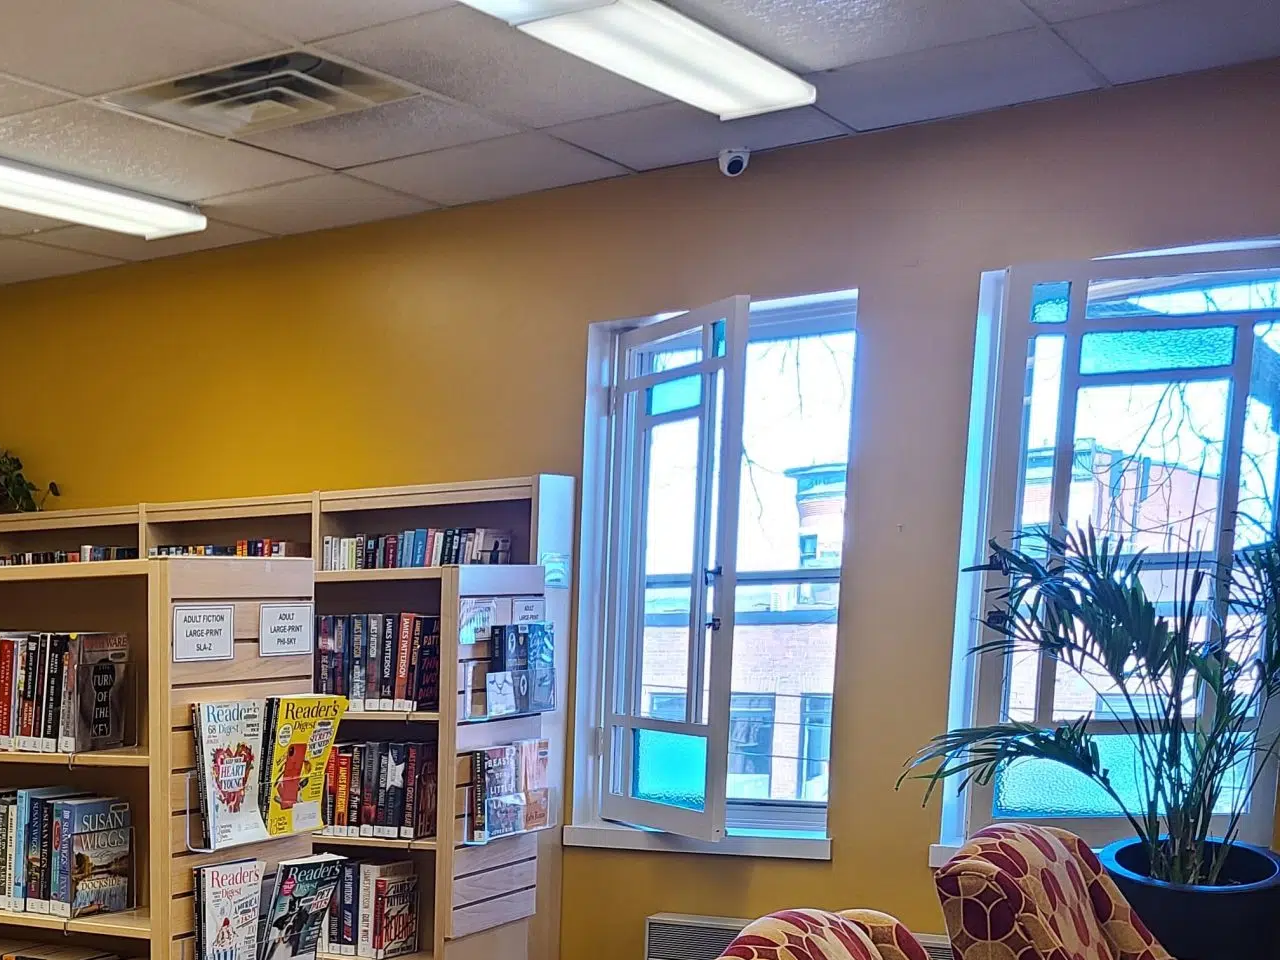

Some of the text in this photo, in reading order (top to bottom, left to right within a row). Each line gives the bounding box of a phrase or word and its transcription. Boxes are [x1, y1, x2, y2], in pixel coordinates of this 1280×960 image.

[183, 614, 225, 624] ADULT FICTION
[278, 612, 295, 621] ADULT
[185, 628, 223, 638] LARGE-PRINT
[270, 624, 303, 633] LARGE-PRINT
[106, 636, 128, 648] WARE
[196, 642, 212, 652] SLA-Z
[276, 637, 297, 646] PHI-SKY
[399, 618, 410, 678] JAMES PATTERSON
[381, 618, 393, 697] JAMES PATTERSON 14
[94, 674, 114, 686] TURN
[97, 692, 108, 702] OF
[95, 706, 109, 718] THE
[206, 702, 260, 723] Reader's
[285, 700, 340, 720] Reader's
[92, 723, 109, 737] KEY
[218, 723, 239, 736] Digest
[294, 720, 317, 732] Digest
[221, 764, 245, 779] HEART
[222, 779, 242, 789] YOUNG
[337, 767, 347, 812] JAMES PATTERSON
[83, 810, 125, 831] SUSAN
[31, 829, 39, 855] WIGGS
[60, 821, 70, 865] SUSAN WIGGS
[80, 830, 125, 851] WIGGS
[40, 841, 48, 868] WIGGS
[211, 866, 260, 889] Reader's
[289, 861, 341, 883] Reader's
[81, 879, 121, 891] DOCKSIDE
[296, 881, 318, 892] Digest
[221, 887, 242, 900] Digest
